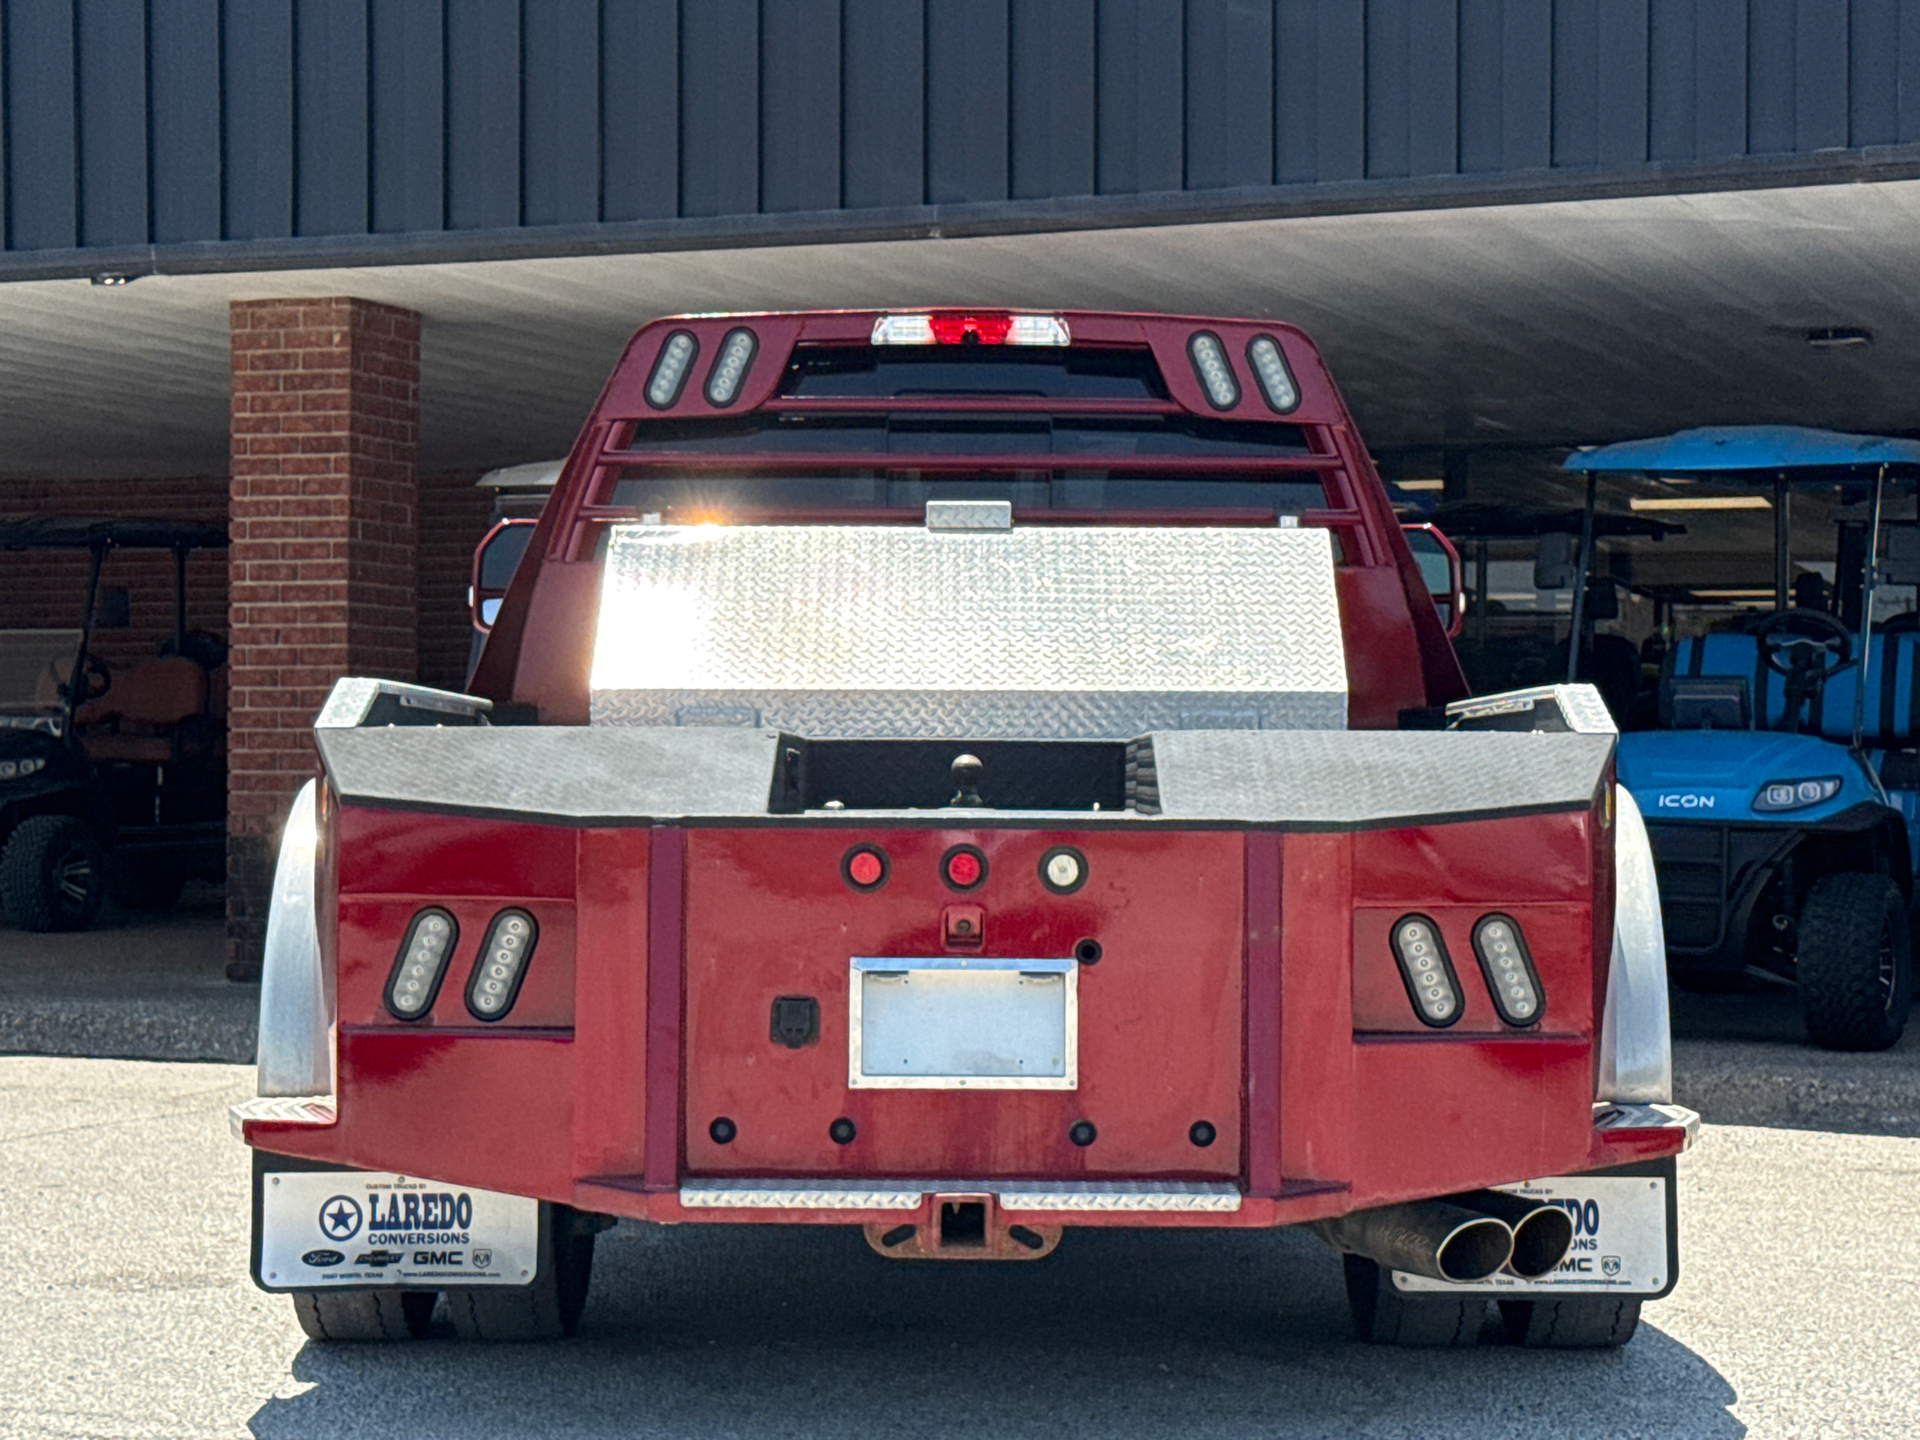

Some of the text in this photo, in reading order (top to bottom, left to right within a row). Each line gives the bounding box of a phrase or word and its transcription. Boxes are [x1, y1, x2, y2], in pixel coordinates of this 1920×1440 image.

[1658, 794, 1715, 808] ICON
[369, 1192, 473, 1231] LAREDO
[368, 1232, 471, 1245] CONVERSIONS
[308, 1252, 339, 1264] Ford
[413, 1251, 464, 1265] GMC
[1552, 1258, 1593, 1272] MC
